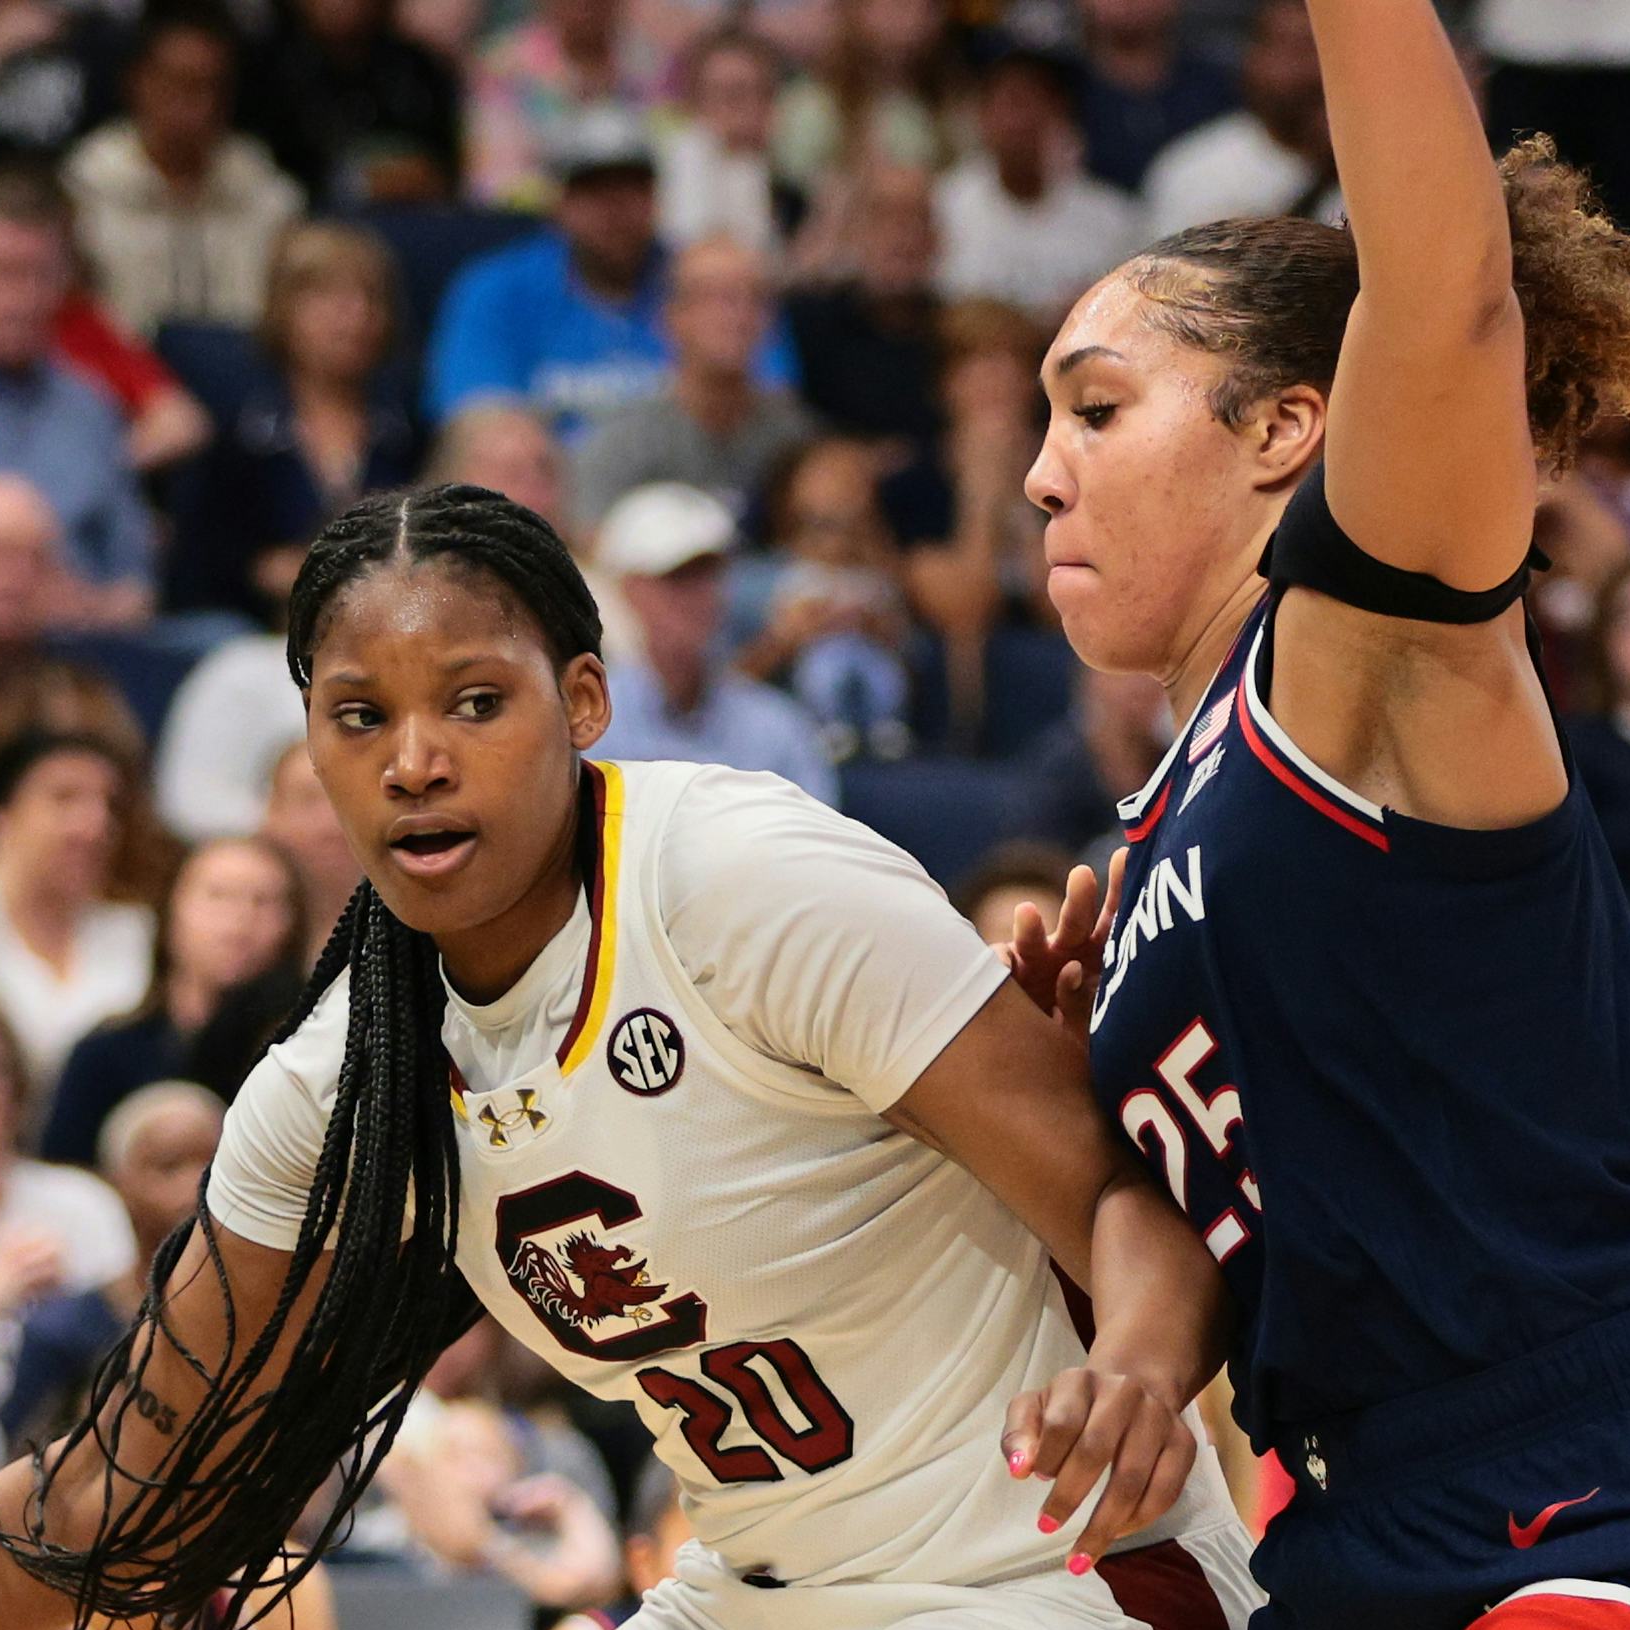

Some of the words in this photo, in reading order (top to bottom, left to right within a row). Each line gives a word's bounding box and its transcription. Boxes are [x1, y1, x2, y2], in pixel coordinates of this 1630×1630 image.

[612, 1013, 679, 1091] SEC
[1119, 1015, 1264, 1265] 25
[634, 1337, 854, 1484] 20
